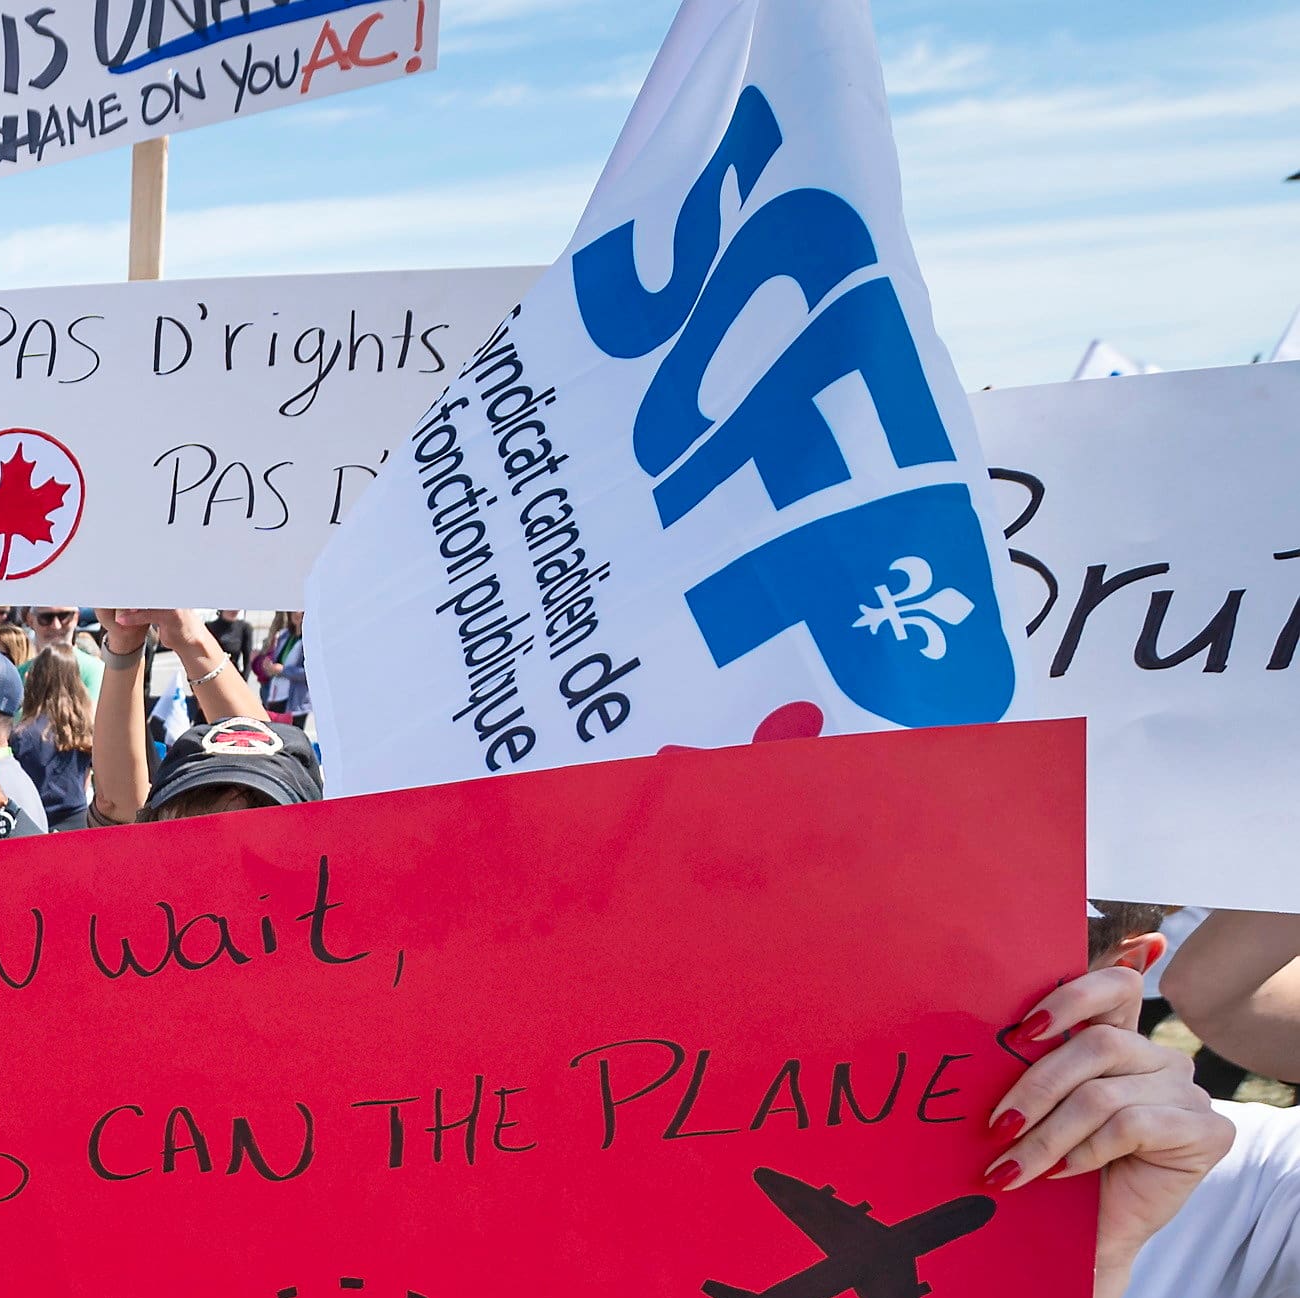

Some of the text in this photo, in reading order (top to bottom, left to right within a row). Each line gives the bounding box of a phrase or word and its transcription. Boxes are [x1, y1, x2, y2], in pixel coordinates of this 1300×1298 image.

[2, 8, 68, 95] IS
[141, 68, 205, 125] ON
[221, 43, 299, 113] YOU
[572, 84, 1016, 728] SCFP
[154, 444, 293, 529] PAS
[412, 396, 498, 585] fonction
[519, 488, 610, 660] canadien
[558, 653, 640, 743] de
[89, 1102, 315, 1182] CAN
[351, 1075, 537, 1168] THE
[571, 1039, 972, 1149] PLANE
